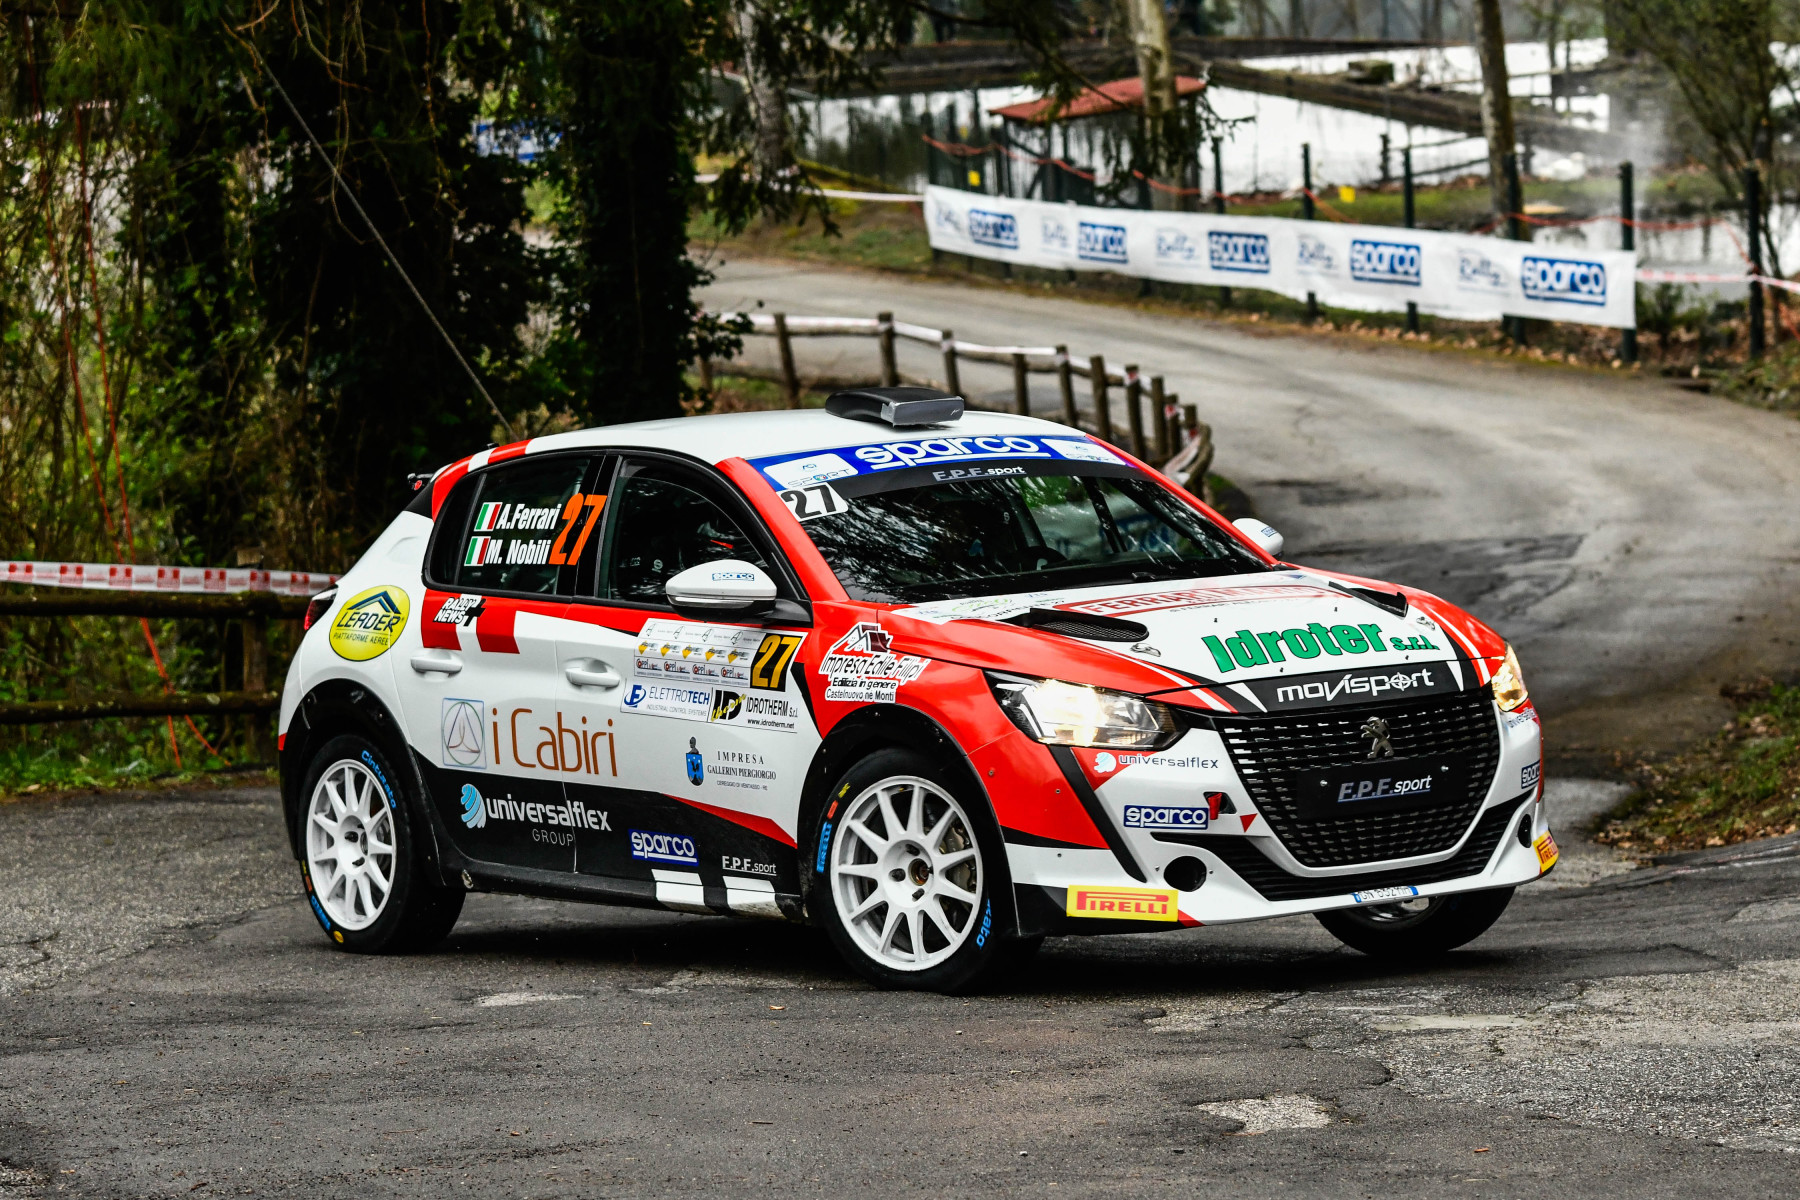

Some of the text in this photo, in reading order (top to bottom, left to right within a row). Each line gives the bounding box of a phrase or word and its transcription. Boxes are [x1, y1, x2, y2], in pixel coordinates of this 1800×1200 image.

[1352, 242, 1421, 284] sparco
[1523, 258, 1606, 302] sparco
[855, 437, 1046, 468] sparco
[781, 484, 837, 517] 27
[496, 503, 562, 530] A.Ferrari
[548, 492, 608, 566] 27
[484, 539, 552, 565] M. Nobili
[432, 608, 465, 624] NEWS
[441, 597, 478, 611] RALLY
[336, 611, 401, 633] LEADER
[1201, 622, 1441, 673] Idroter s.r.l.
[751, 634, 802, 688] 27
[648, 686, 710, 705] ELETTROTECH
[858, 678, 867, 688] in
[866, 680, 897, 690] genere
[874, 690, 895, 702] Monti
[745, 696, 789, 717] IDROTHERM
[747, 718, 795, 729] www.idrotherm.net
[492, 707, 618, 777] i Cabiri
[717, 750, 764, 765] IMPRESA
[1119, 754, 1219, 769] universalflex
[361, 750, 397, 809] Cinturato
[707, 764, 777, 780] GALLERINI PIERGIORGIO
[486, 793, 612, 832] universalflex
[1126, 807, 1207, 828] sparco
[532, 828, 574, 846] GROUP
[631, 831, 697, 862] sparco
[1076, 890, 1170, 915] PIRELLI
